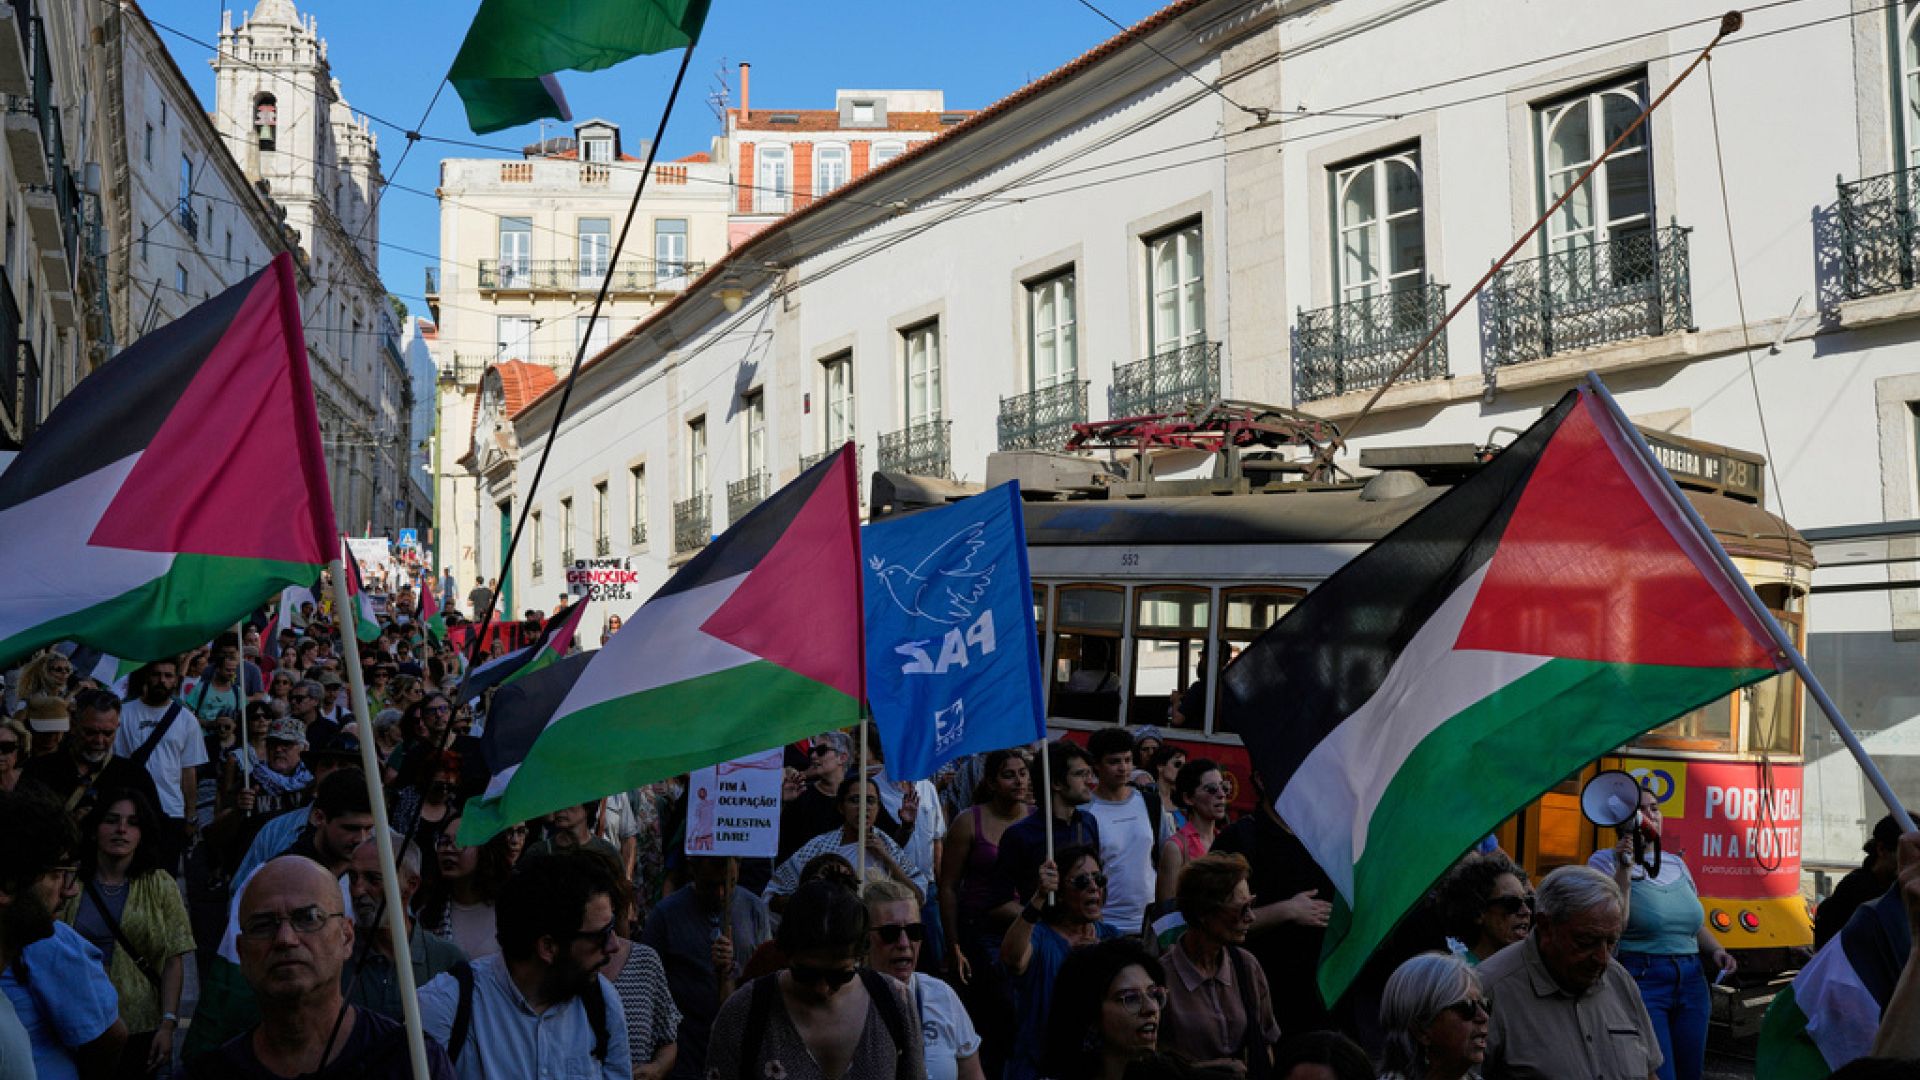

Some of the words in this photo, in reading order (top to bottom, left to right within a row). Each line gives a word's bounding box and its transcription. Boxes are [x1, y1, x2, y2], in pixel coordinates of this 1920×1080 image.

[1727, 459, 1747, 487] 28
[720, 782, 738, 791] FIM
[718, 795, 777, 808] OCUPAÇÃO!
[717, 818, 772, 828] PALESTINA
[716, 831, 750, 842] LIVRE!
[1702, 832, 1723, 857] IN
[1728, 834, 1740, 858] A
